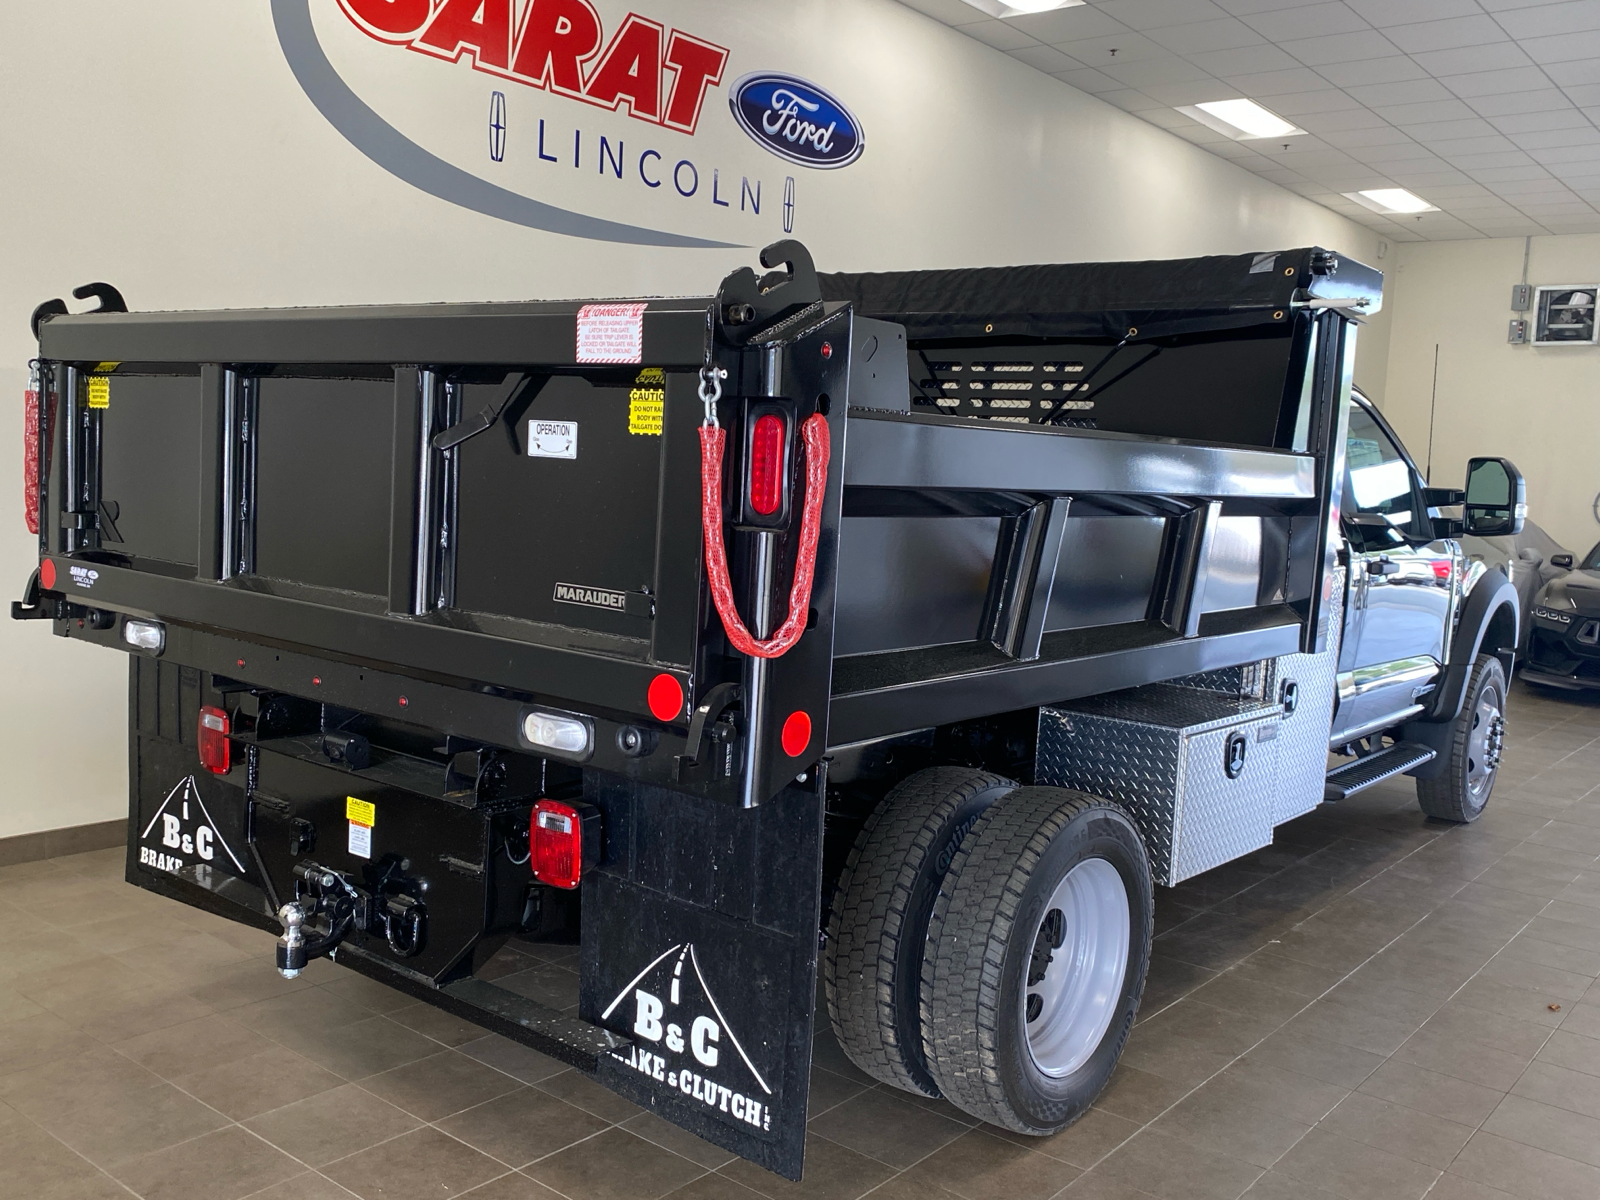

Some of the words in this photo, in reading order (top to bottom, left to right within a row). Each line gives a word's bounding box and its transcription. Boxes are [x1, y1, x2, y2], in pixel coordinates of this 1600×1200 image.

[763, 89, 836, 153] Ford
[538, 119, 761, 215] LINCOLN
[632, 392, 664, 401] CAUTIO
[536, 423, 570, 436] OPERATION
[679, 1069, 762, 1127] CLUTCH
